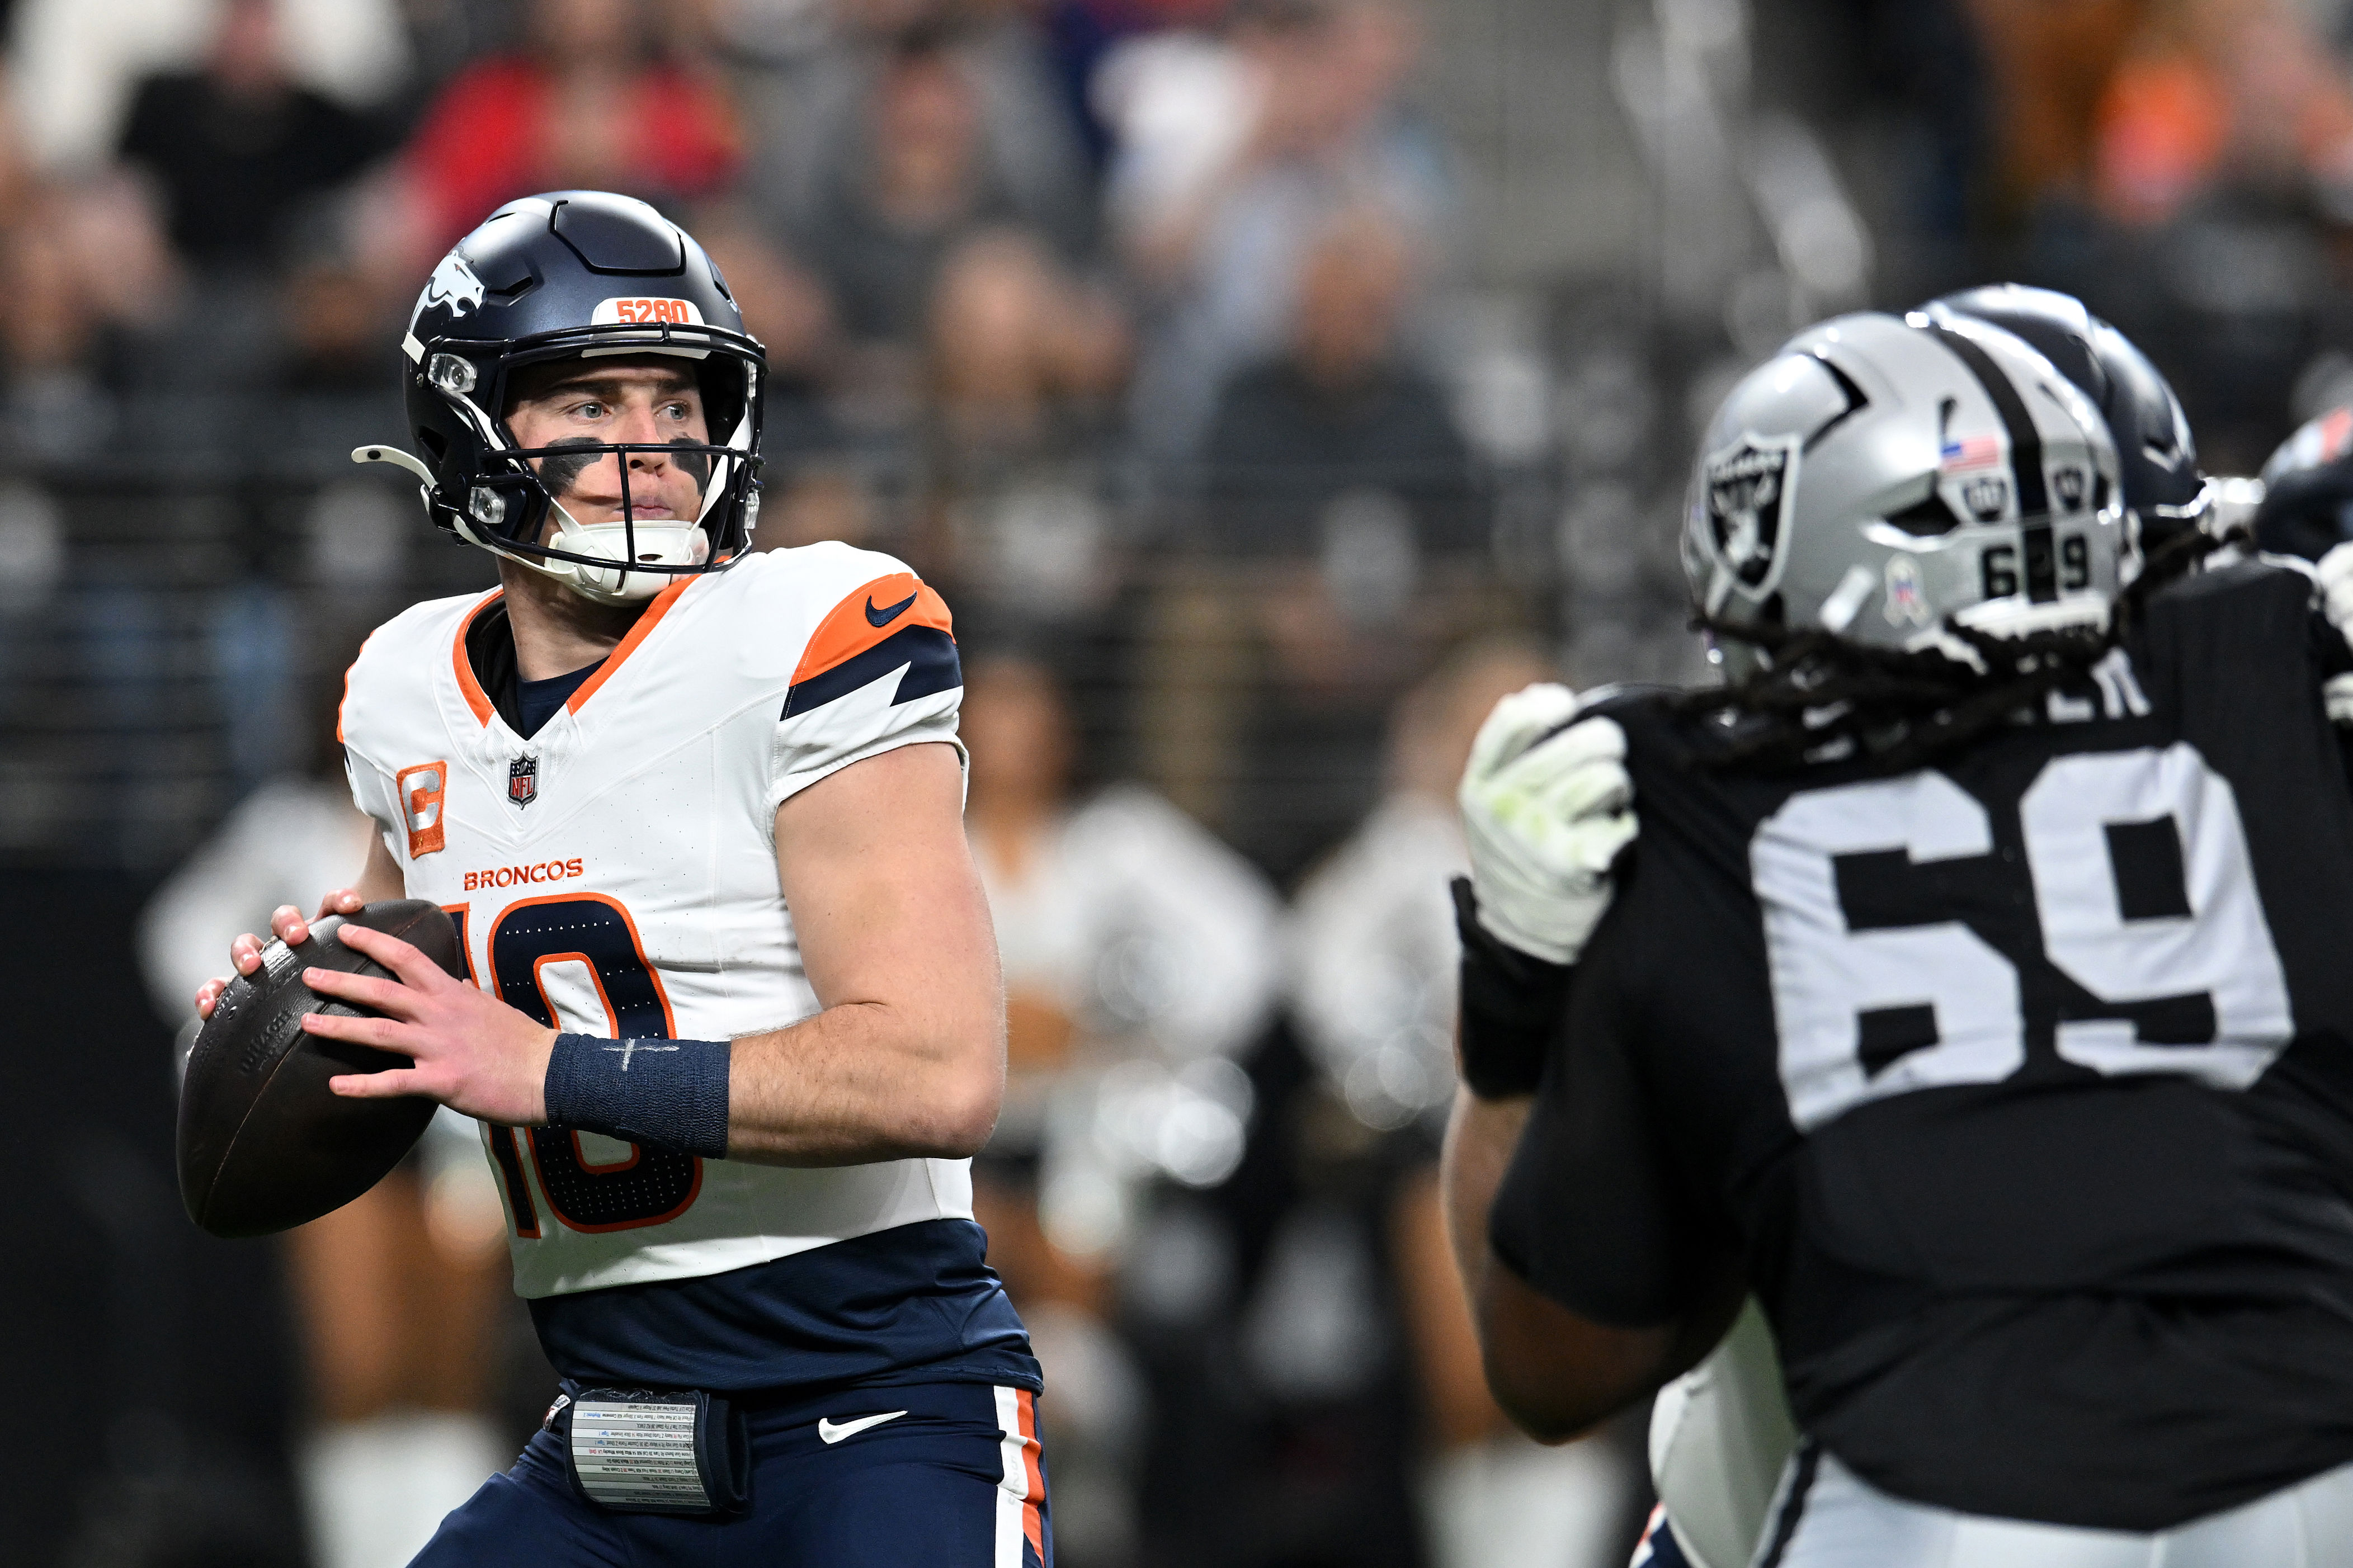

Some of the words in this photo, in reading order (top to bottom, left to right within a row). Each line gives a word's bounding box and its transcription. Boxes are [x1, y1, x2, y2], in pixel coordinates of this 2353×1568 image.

[616, 300, 689, 323] 5280
[402, 769, 440, 833] C
[512, 777, 534, 798] NFL
[464, 858, 584, 891] BRONCOS
[1749, 741, 2295, 1134] 69
